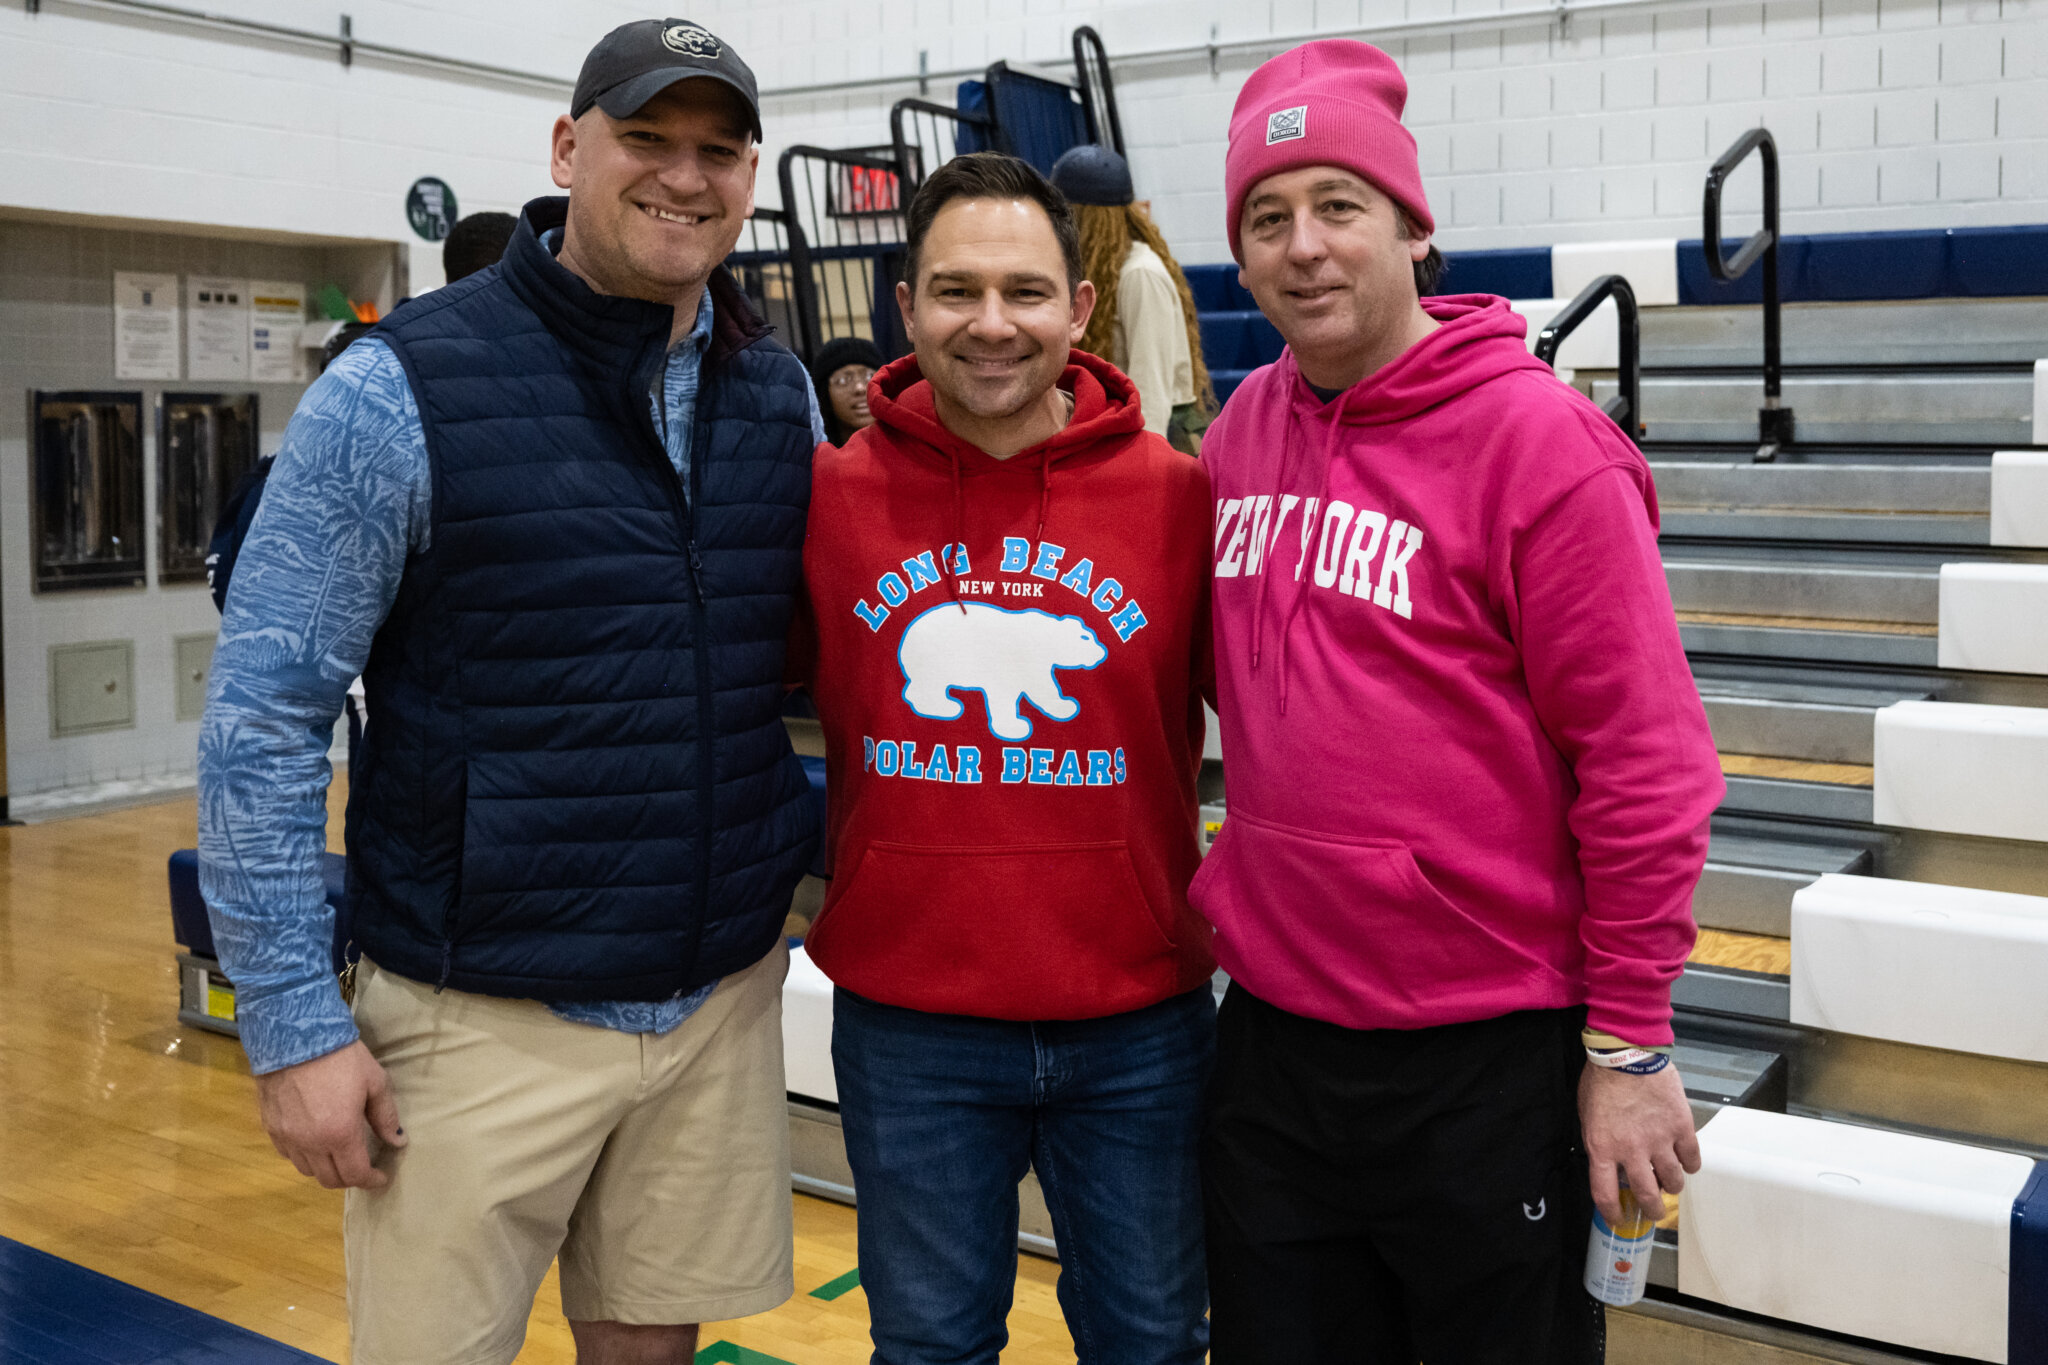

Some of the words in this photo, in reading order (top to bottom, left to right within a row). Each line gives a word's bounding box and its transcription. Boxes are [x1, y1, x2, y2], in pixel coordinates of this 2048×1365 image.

[1273, 129, 1297, 137] DIXXON
[853, 541, 971, 633] LONG
[999, 536, 1149, 643] BEACH
[958, 580, 994, 595] NEW
[1002, 581, 1044, 597] YORK
[863, 735, 982, 784] POLAR
[1000, 747, 1127, 786] BEARS
